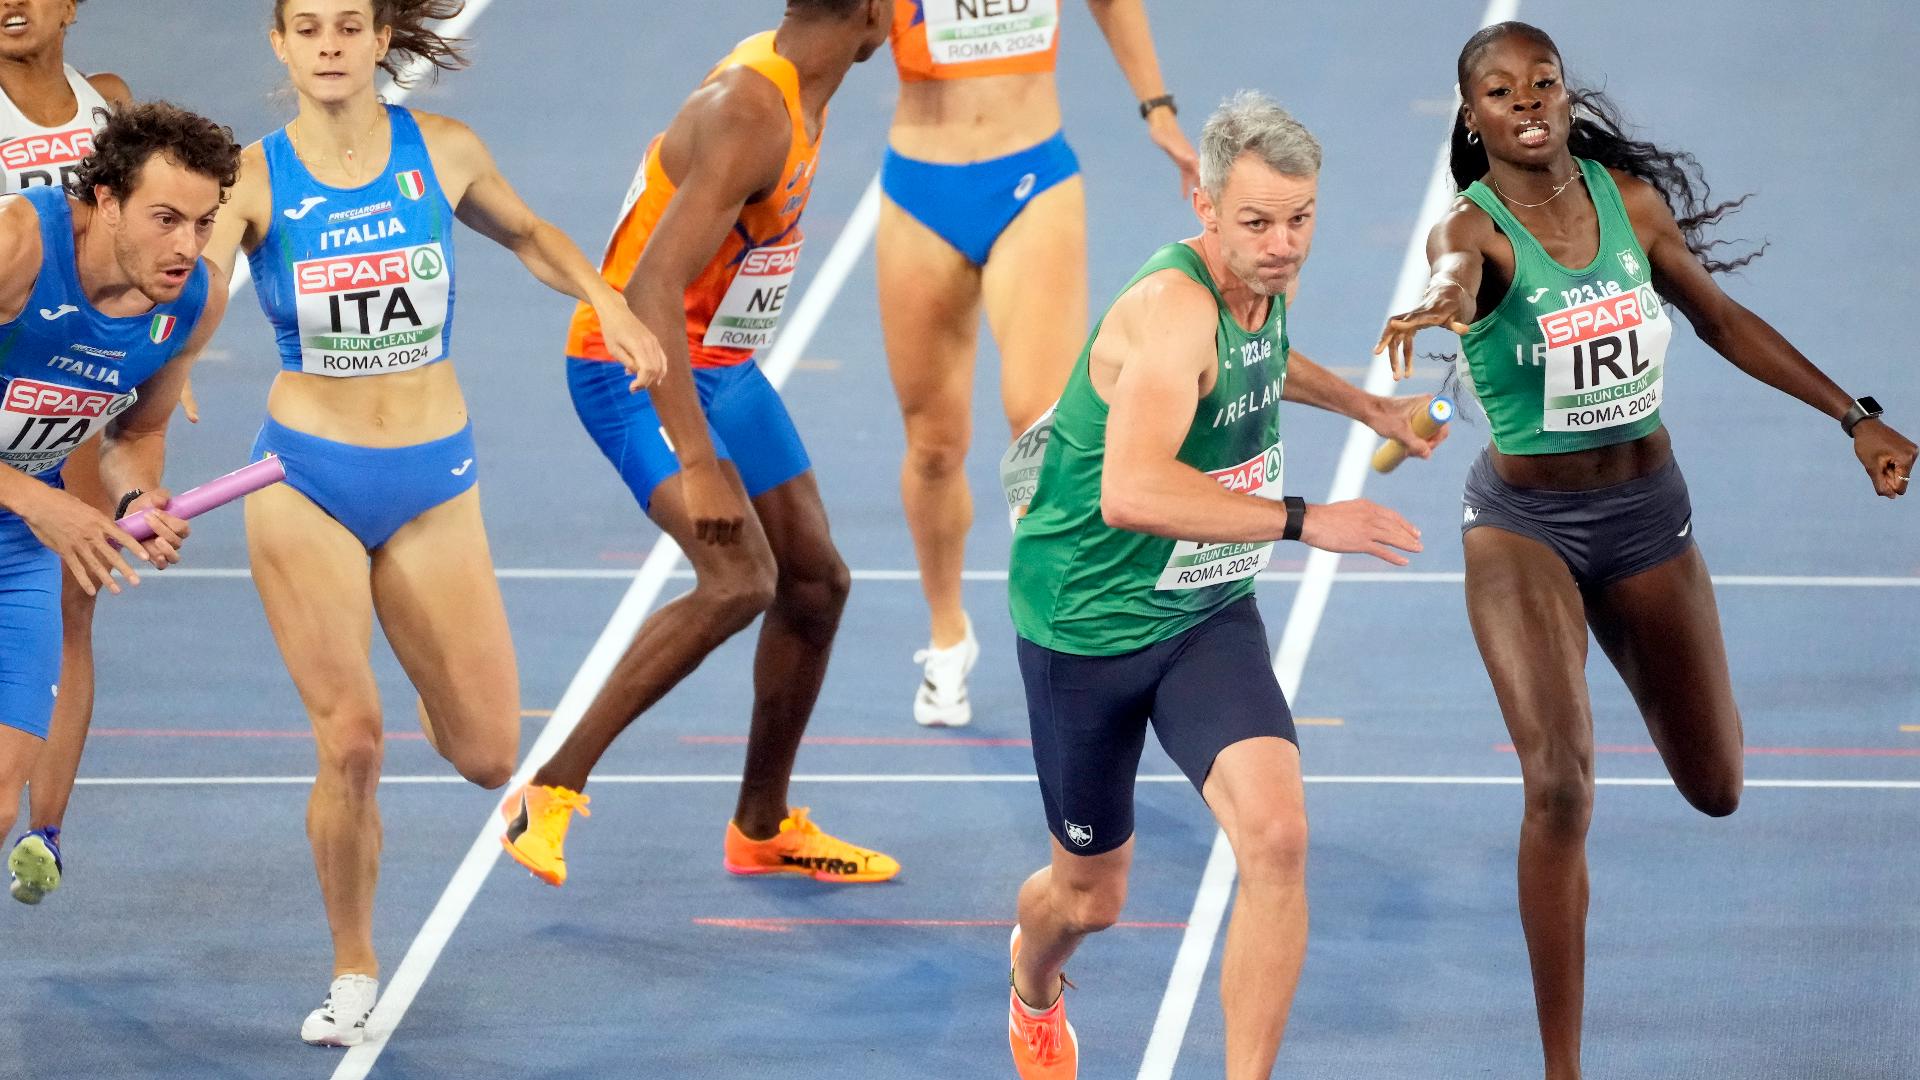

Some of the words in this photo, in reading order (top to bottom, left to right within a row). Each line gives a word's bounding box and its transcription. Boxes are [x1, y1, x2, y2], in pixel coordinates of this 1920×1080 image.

[948, 44, 1001, 59] ROMA
[1007, 33, 1045, 53] 2024
[2, 131, 95, 166] SPAR
[328, 201, 393, 222] FRECCIAROSSA
[320, 217, 407, 250] ITALIA
[301, 256, 408, 290] SPAR
[743, 250, 799, 273] SPA
[328, 286, 422, 335] ITA
[747, 284, 788, 313] NE
[1547, 298, 1640, 344] SPAR
[323, 354, 383, 370] ROMA
[388, 345, 429, 367] 2024
[333, 340, 338, 349] I
[339, 338, 371, 350] RUN
[1240, 338, 1271, 367] 123.ie
[47, 355, 120, 386] ITALIA
[1572, 329, 1650, 391] IRL
[9, 384, 110, 414] SPAR
[1567, 405, 1625, 427] ROMA
[1629, 389, 1657, 416] 2024
[1577, 395, 1581, 406] I
[1584, 390, 1612, 404] RUN
[7, 416, 91, 450] ITA
[1217, 461, 1264, 492] PAR
[1199, 550, 1220, 563] RUN
[1221, 542, 1254, 558] CLEAN
[1177, 563, 1223, 584] ROMA
[1226, 553, 1260, 575] 2024
